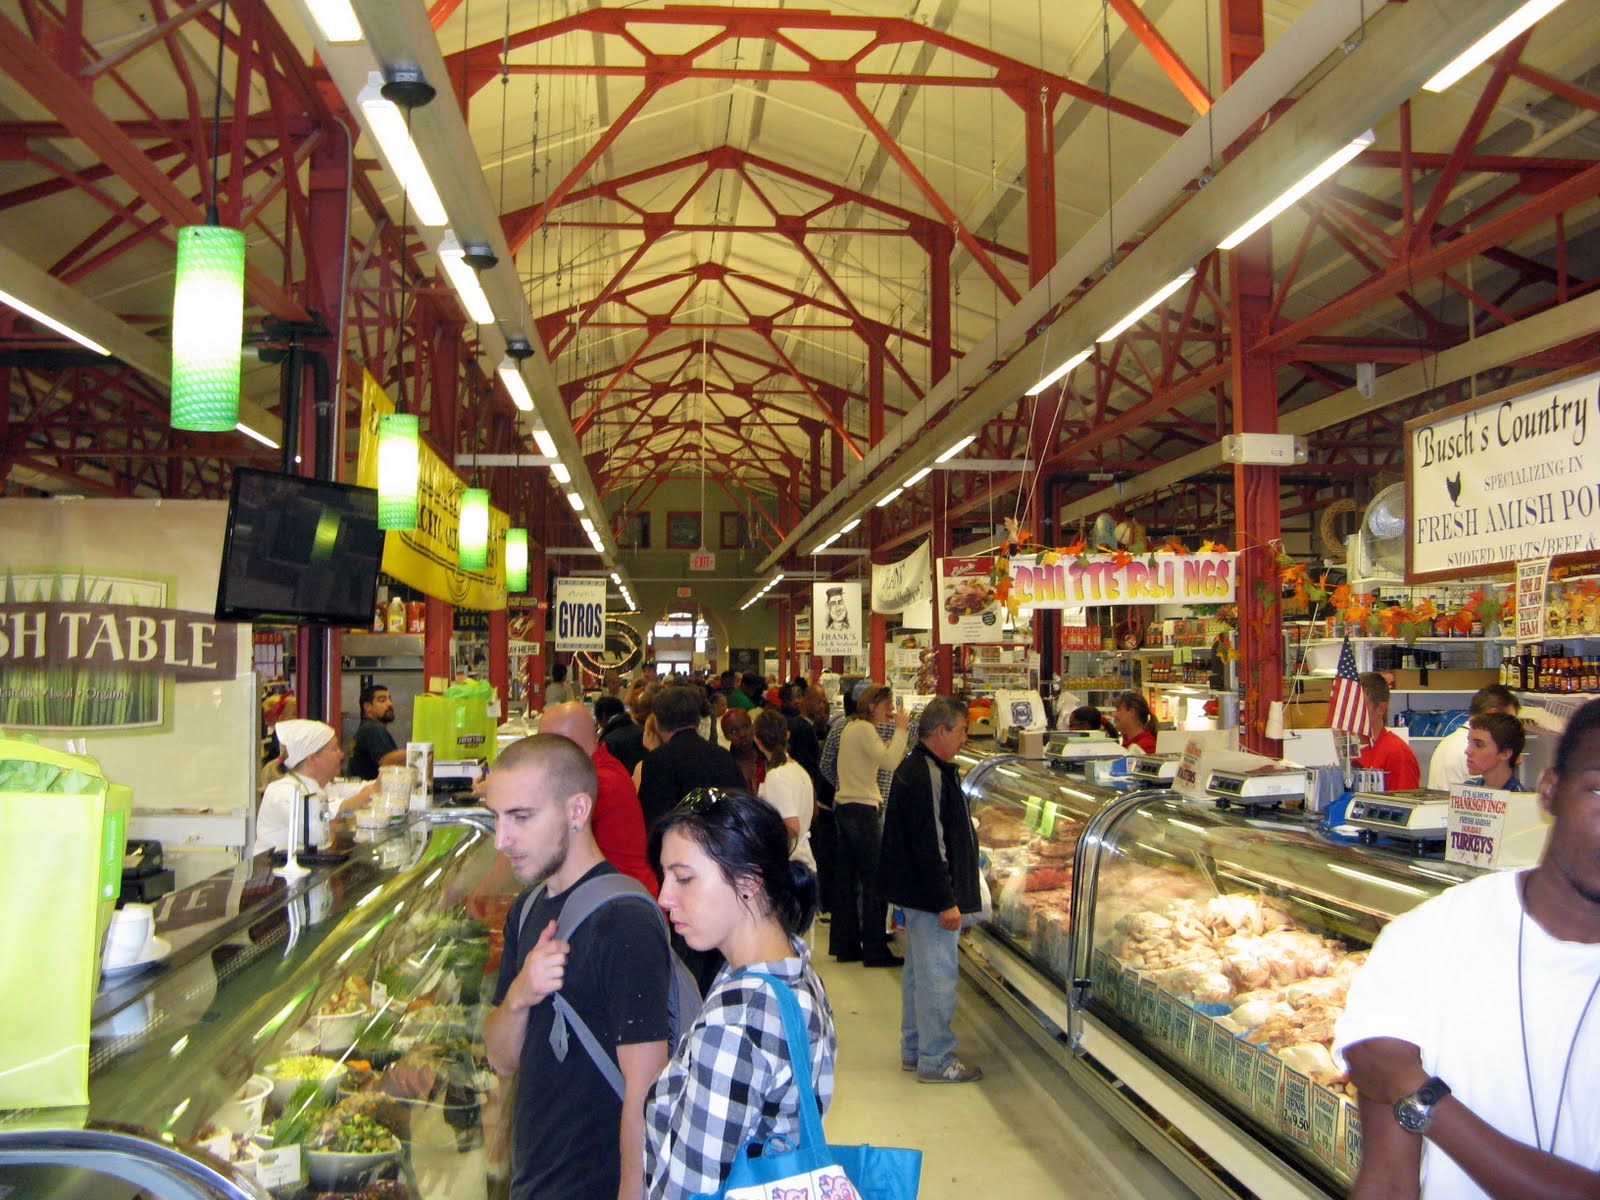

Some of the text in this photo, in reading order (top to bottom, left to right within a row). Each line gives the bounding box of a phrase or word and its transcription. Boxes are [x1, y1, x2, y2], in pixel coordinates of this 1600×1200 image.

[1417, 411, 1489, 468] Busch's
[1497, 395, 1588, 447] Country
[1483, 454, 1585, 492] SPECIALIZING IN
[1417, 507, 1479, 545] FRESH
[1485, 492, 1553, 534] AMISH
[1447, 547, 1496, 569] SMOKED
[558, 600, 603, 640] GYROS
[1520, 621, 1539, 636] HAM
[59, 611, 219, 671] TABLE
[820, 633, 857, 641] FRANK'S
[87, 687, 129, 701] Organic
[1450, 795, 1506, 815] THANKSGIVING!!
[1472, 791, 1493, 800] ALMOST
[1450, 831, 1493, 855] TURKEYS
[1285, 1095, 1307, 1117] HENS
[1292, 1113, 1309, 1132] 9.50
